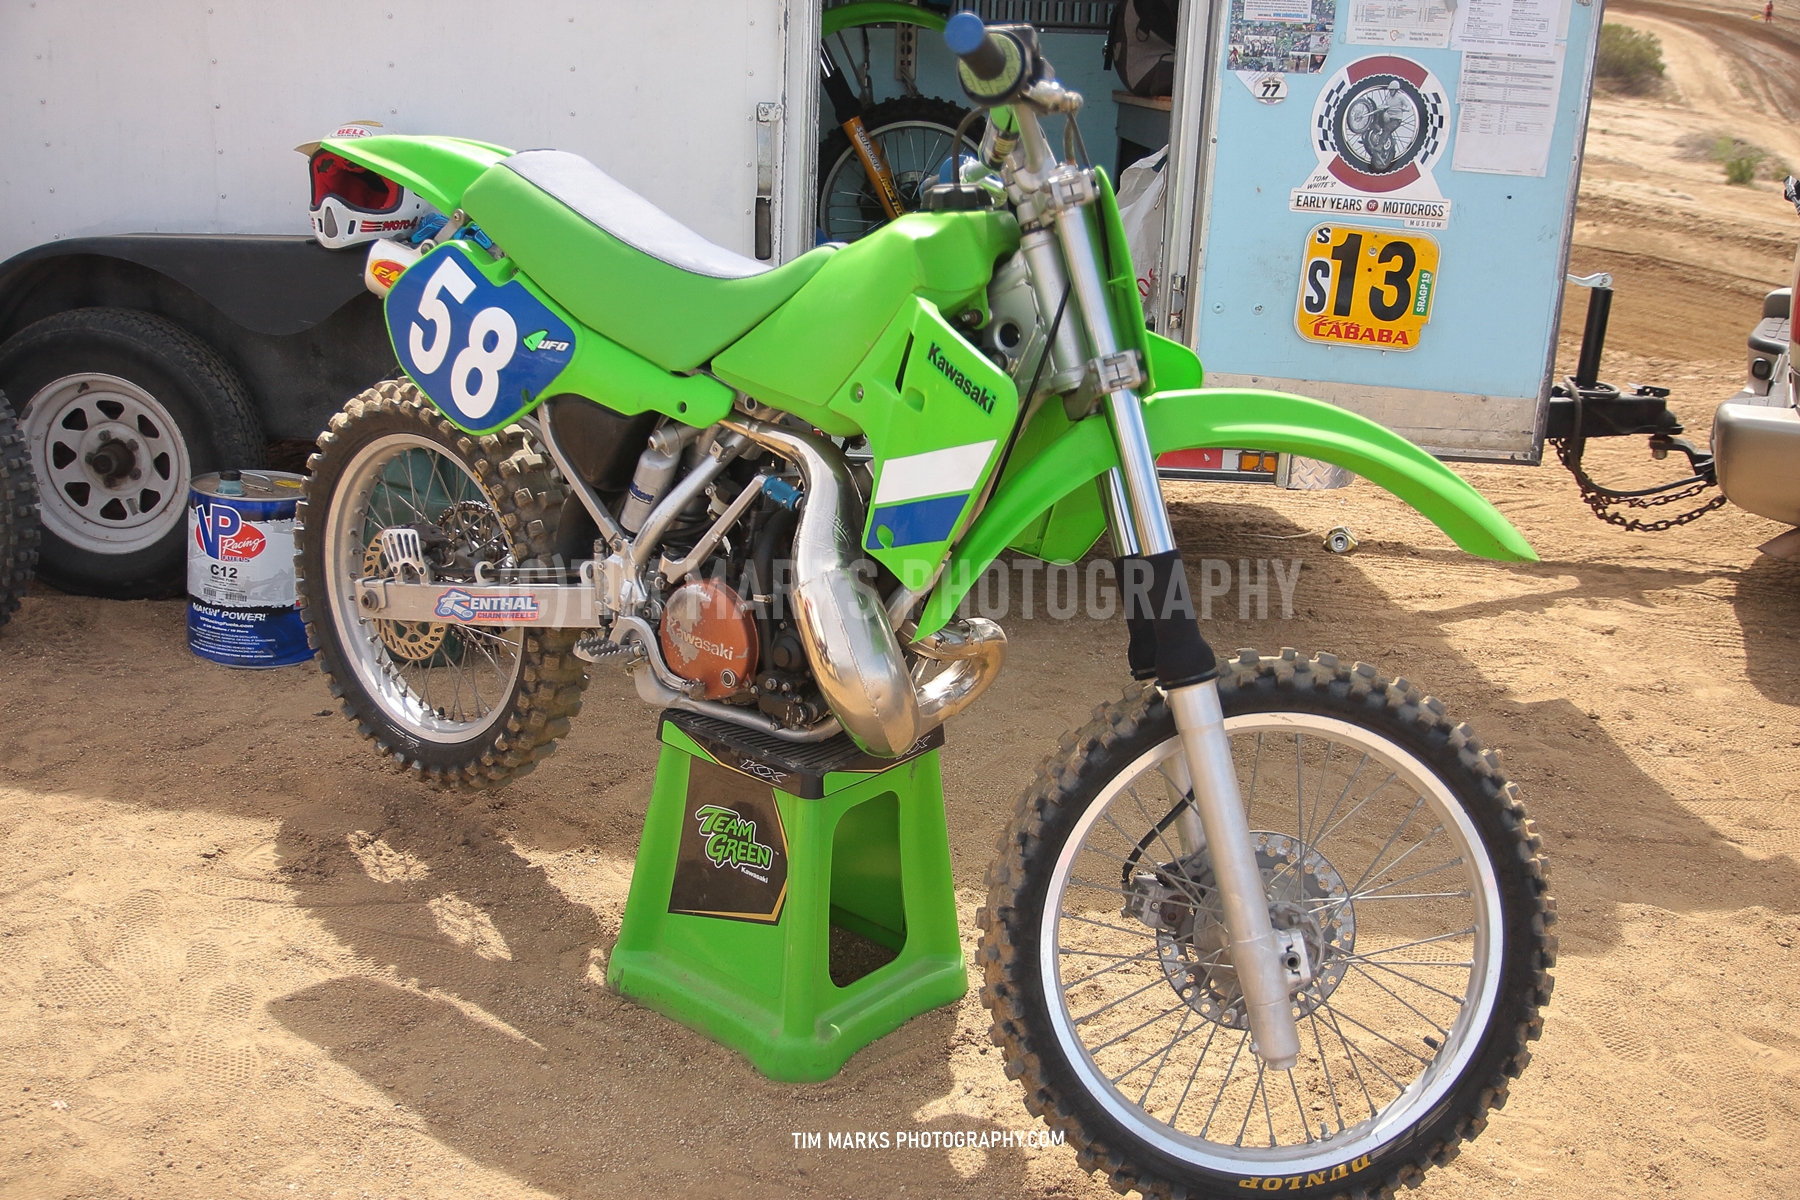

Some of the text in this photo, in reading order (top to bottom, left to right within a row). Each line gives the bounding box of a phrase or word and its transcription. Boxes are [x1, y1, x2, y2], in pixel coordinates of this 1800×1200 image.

[1262, 84, 1280, 97] 77
[337, 128, 366, 136] BELL
[1296, 194, 1444, 217] EARLY YEARS OF MOTOCROSS
[1317, 227, 1331, 243] S
[1409, 220, 1442, 228] MUSEUM
[1305, 260, 1330, 313] S
[1331, 233, 1416, 321] 13
[409, 256, 517, 418] 58
[1314, 321, 1408, 345] CABABA
[538, 340, 569, 351] UFO
[927, 341, 997, 415] Kawasaki
[196, 503, 242, 560] VP
[222, 537, 266, 555] Racing
[211, 564, 238, 579] C12
[221, 610, 266, 622] POWER!
[668, 616, 734, 661] Kawasaki
[740, 759, 787, 783] KX
[697, 806, 755, 843] TEAM
[706, 833, 771, 867] GREEN
[741, 866, 769, 884] Kawasaki
[1238, 1153, 1372, 1191] DUNLOP
